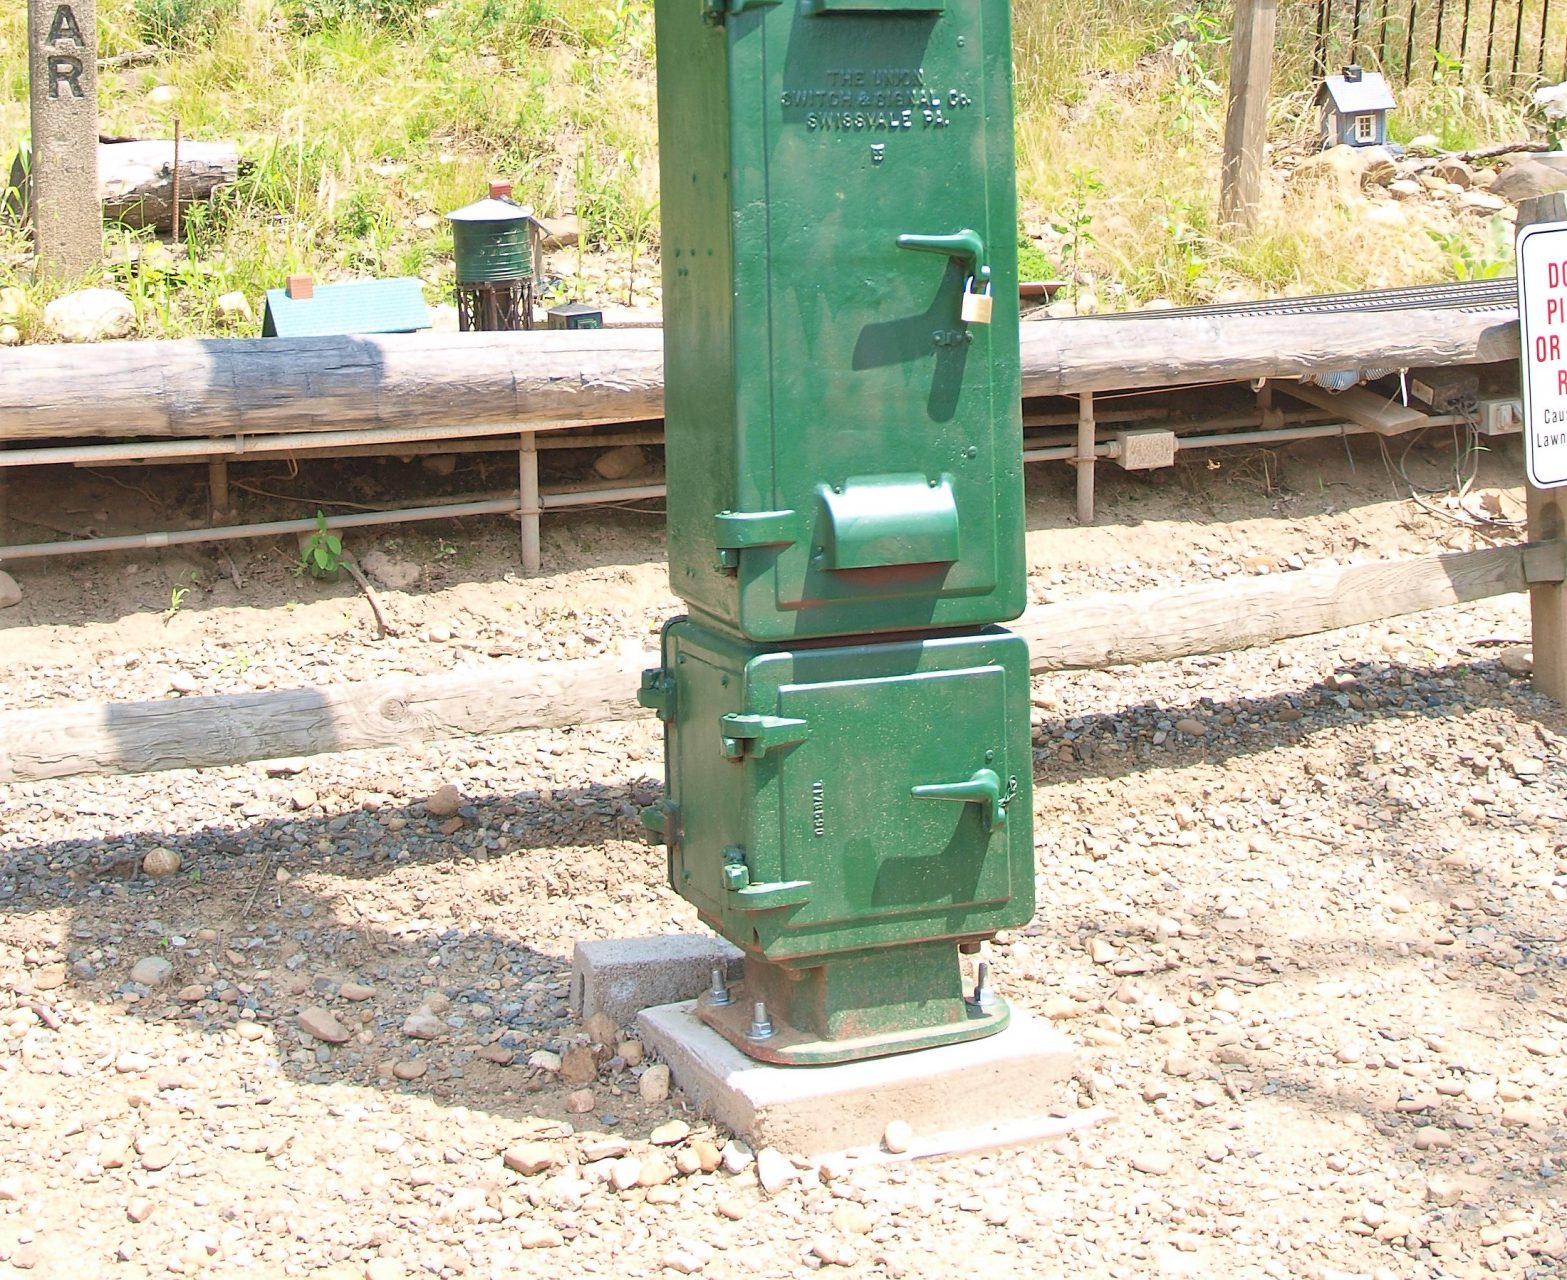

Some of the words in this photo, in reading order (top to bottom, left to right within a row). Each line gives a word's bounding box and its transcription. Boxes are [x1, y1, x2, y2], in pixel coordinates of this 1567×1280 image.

[827, 69, 866, 88] THE
[780, 90, 851, 110] SWITCH
[807, 111, 912, 129] SWISSVALE
[1536, 334, 1560, 363] OR
[1544, 409, 1567, 424] Cau
